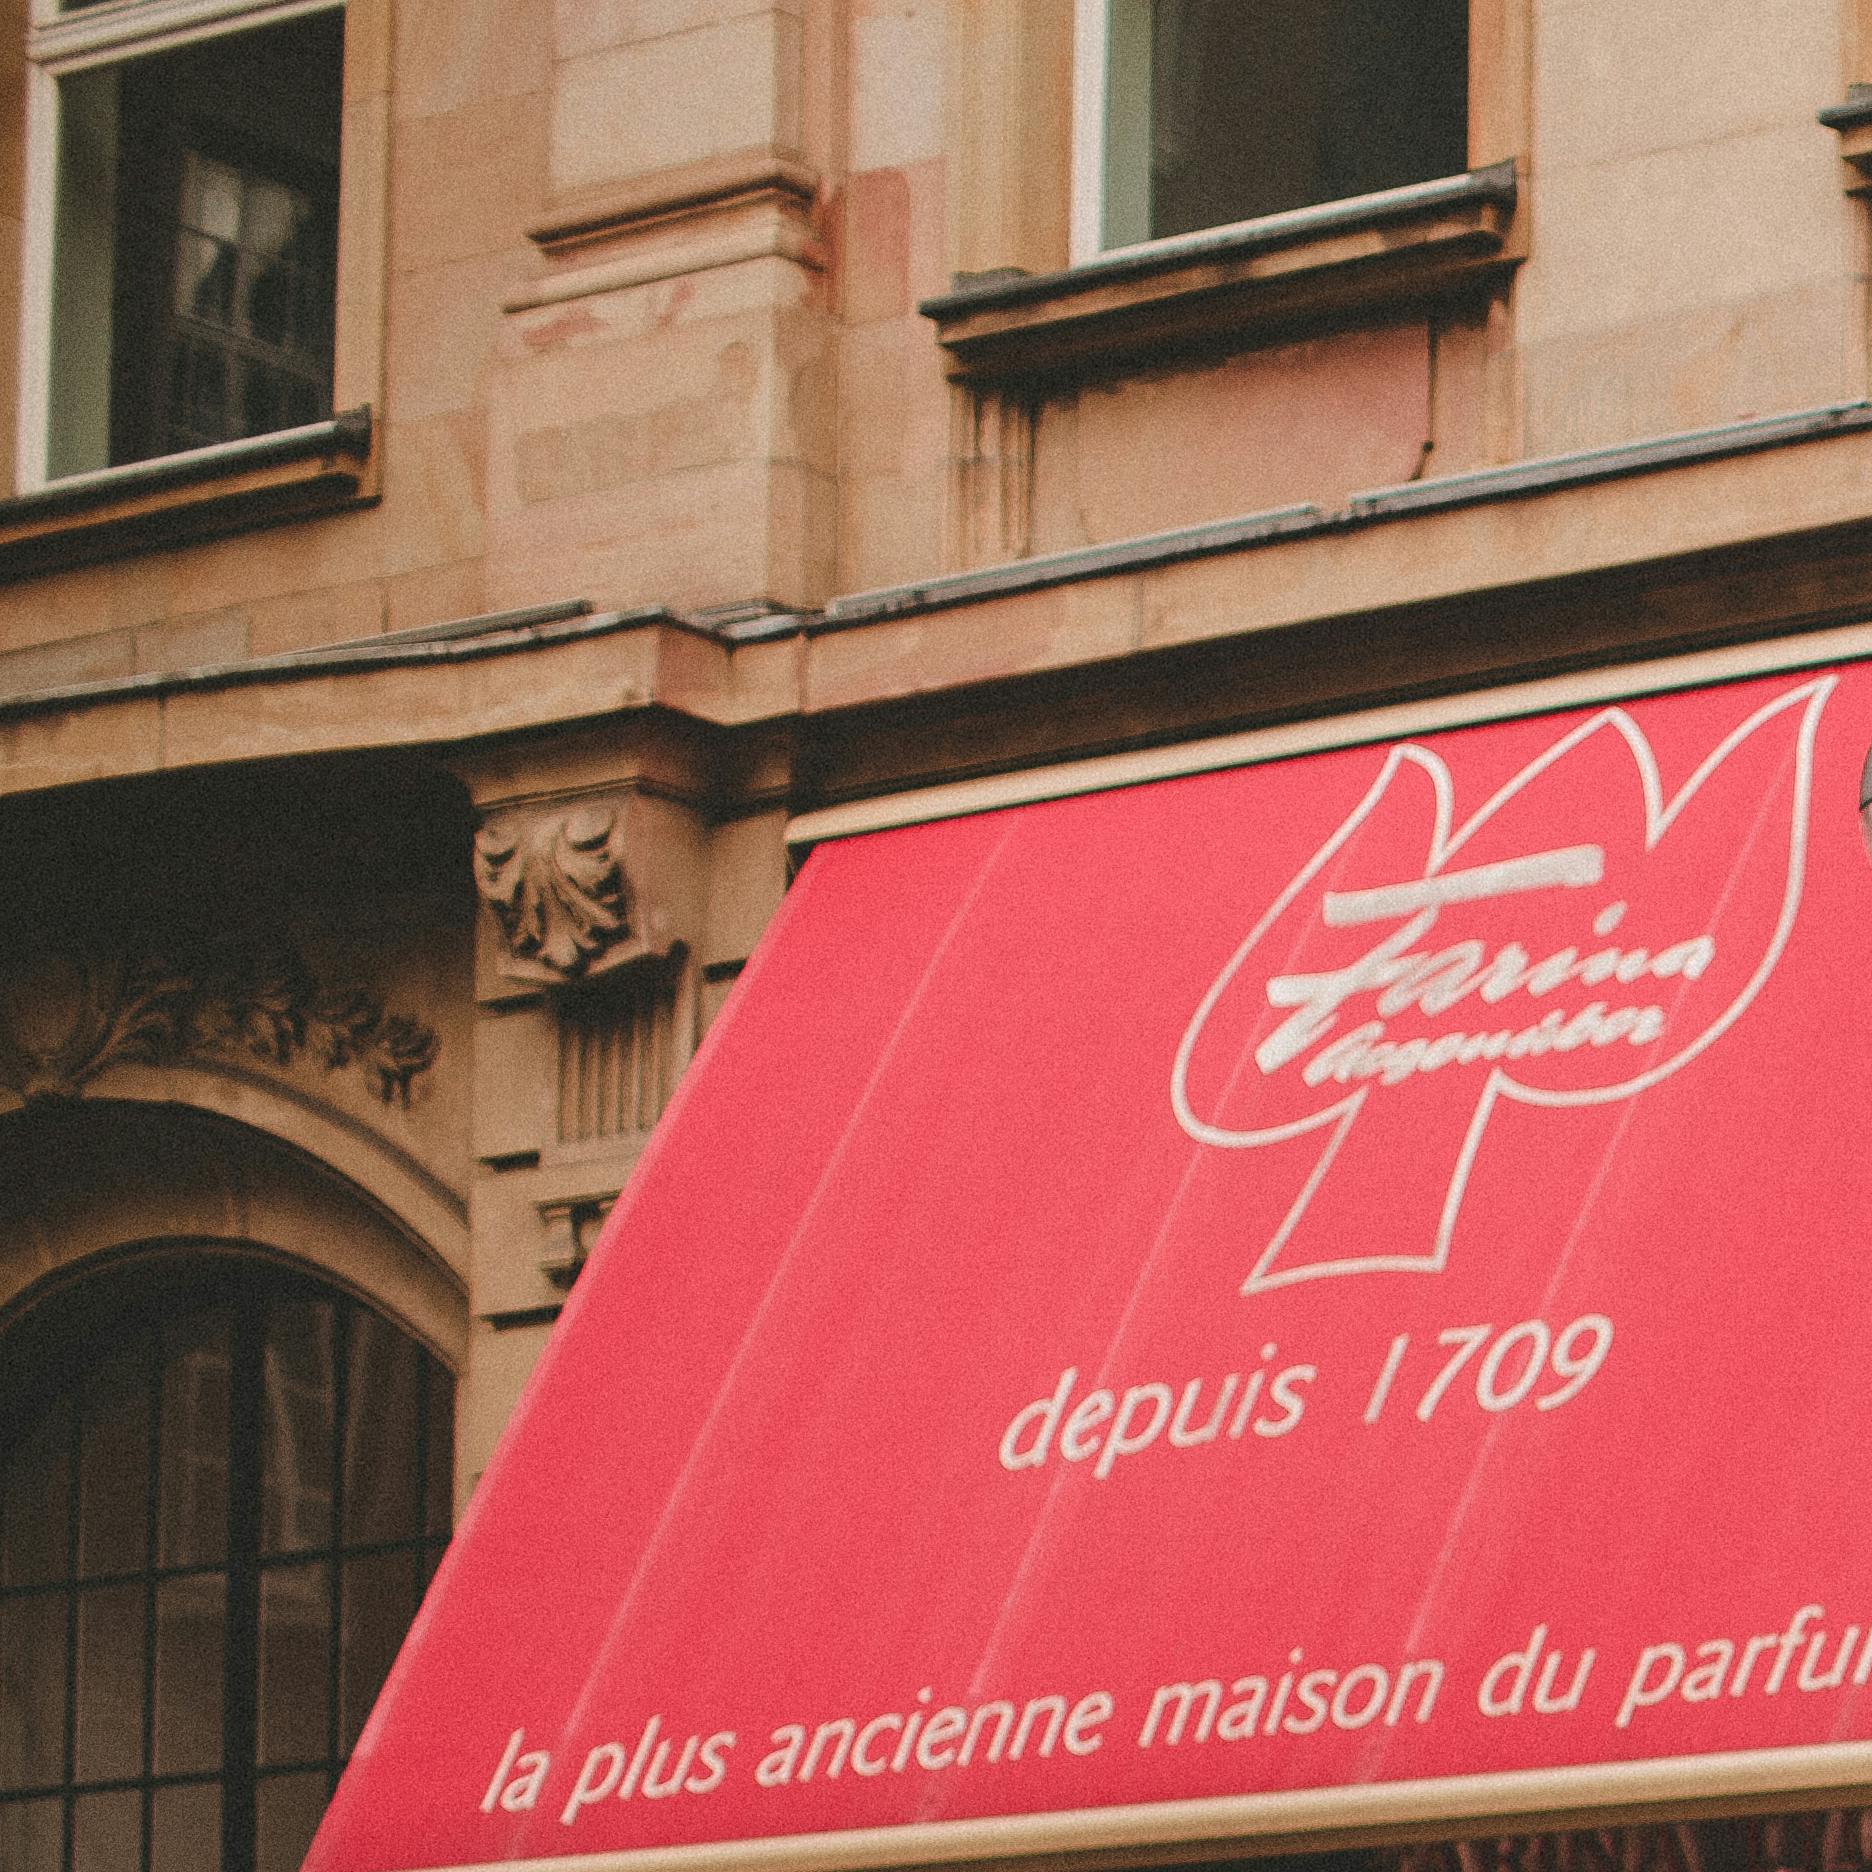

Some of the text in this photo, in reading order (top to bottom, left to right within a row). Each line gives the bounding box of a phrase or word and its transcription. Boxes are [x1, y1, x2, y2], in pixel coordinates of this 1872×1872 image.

[1255, 843, 1715, 1074] Farina
[998, 1312, 1614, 1480] depuis 1709
[479, 1727, 551, 1814] la
[559, 1712, 737, 1826] plus
[755, 1685, 1113, 1788] ancienne
[1136, 1646, 1445, 1750] maison
[1475, 1623, 1596, 1718] du
